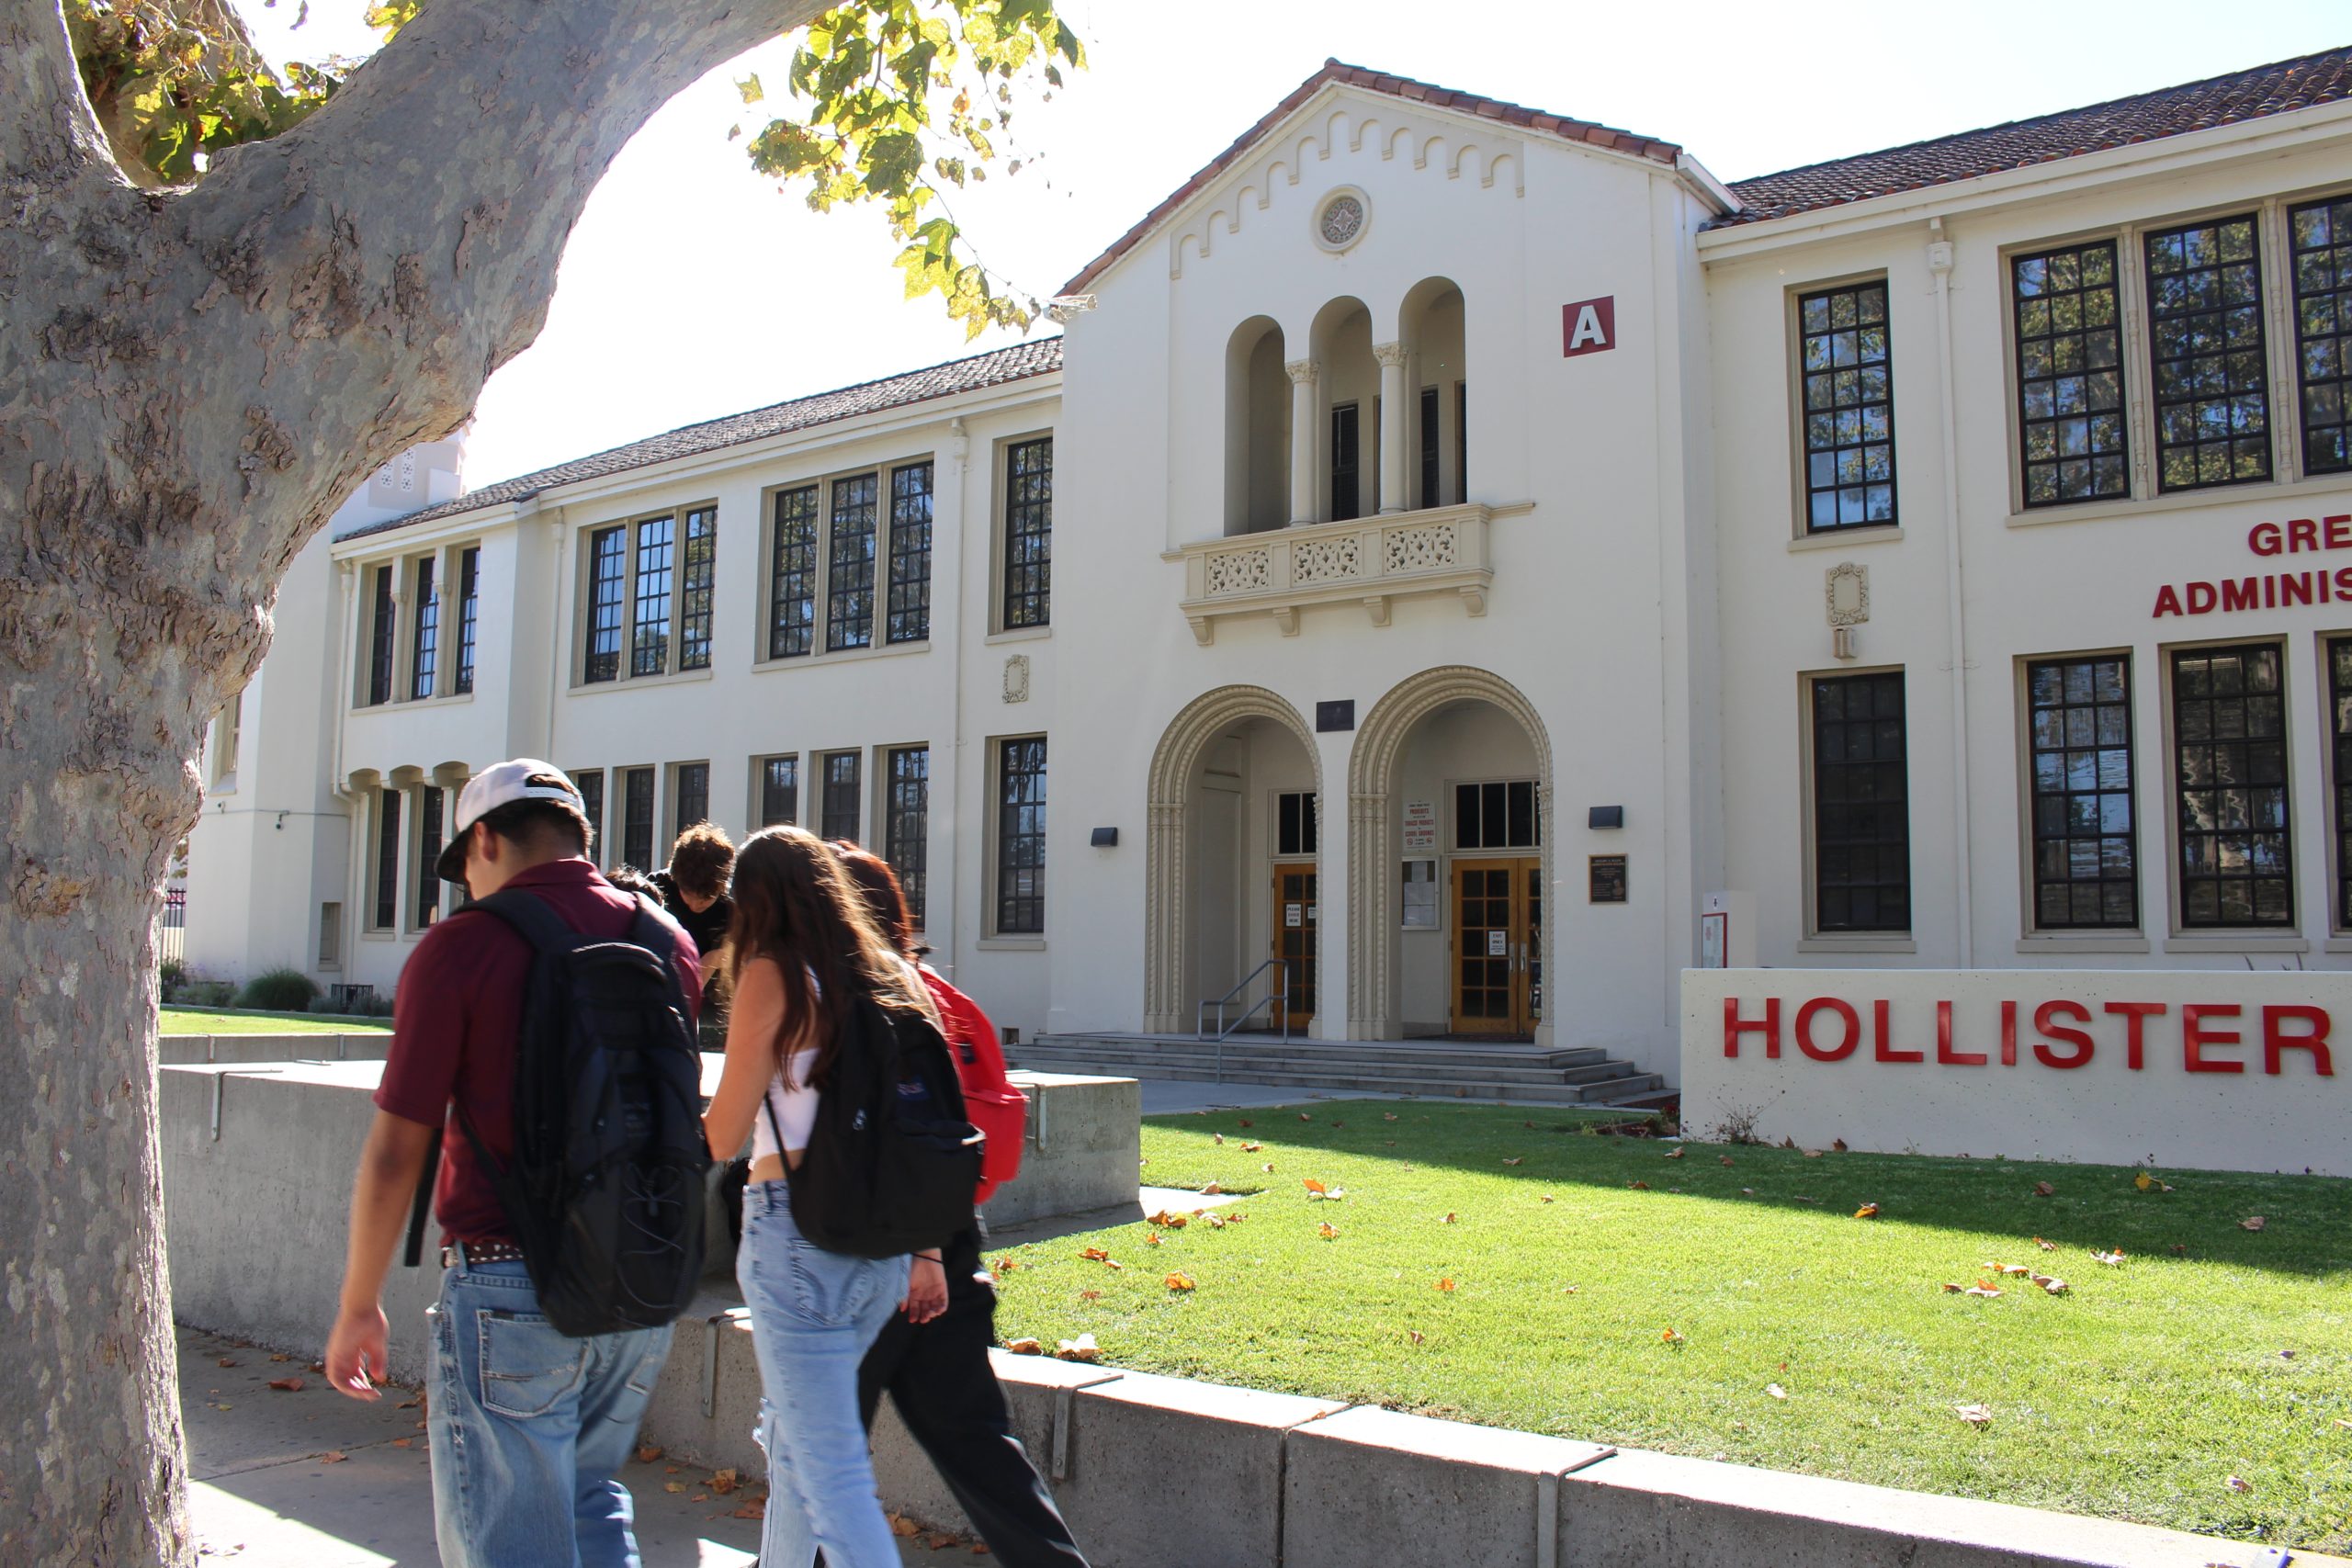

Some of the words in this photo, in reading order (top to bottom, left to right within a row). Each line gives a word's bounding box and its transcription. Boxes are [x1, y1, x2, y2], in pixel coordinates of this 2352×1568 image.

[1570, 305, 1607, 349] A
[2248, 514, 2352, 557] GRE
[1723, 997, 2335, 1077] HOLLISTER
